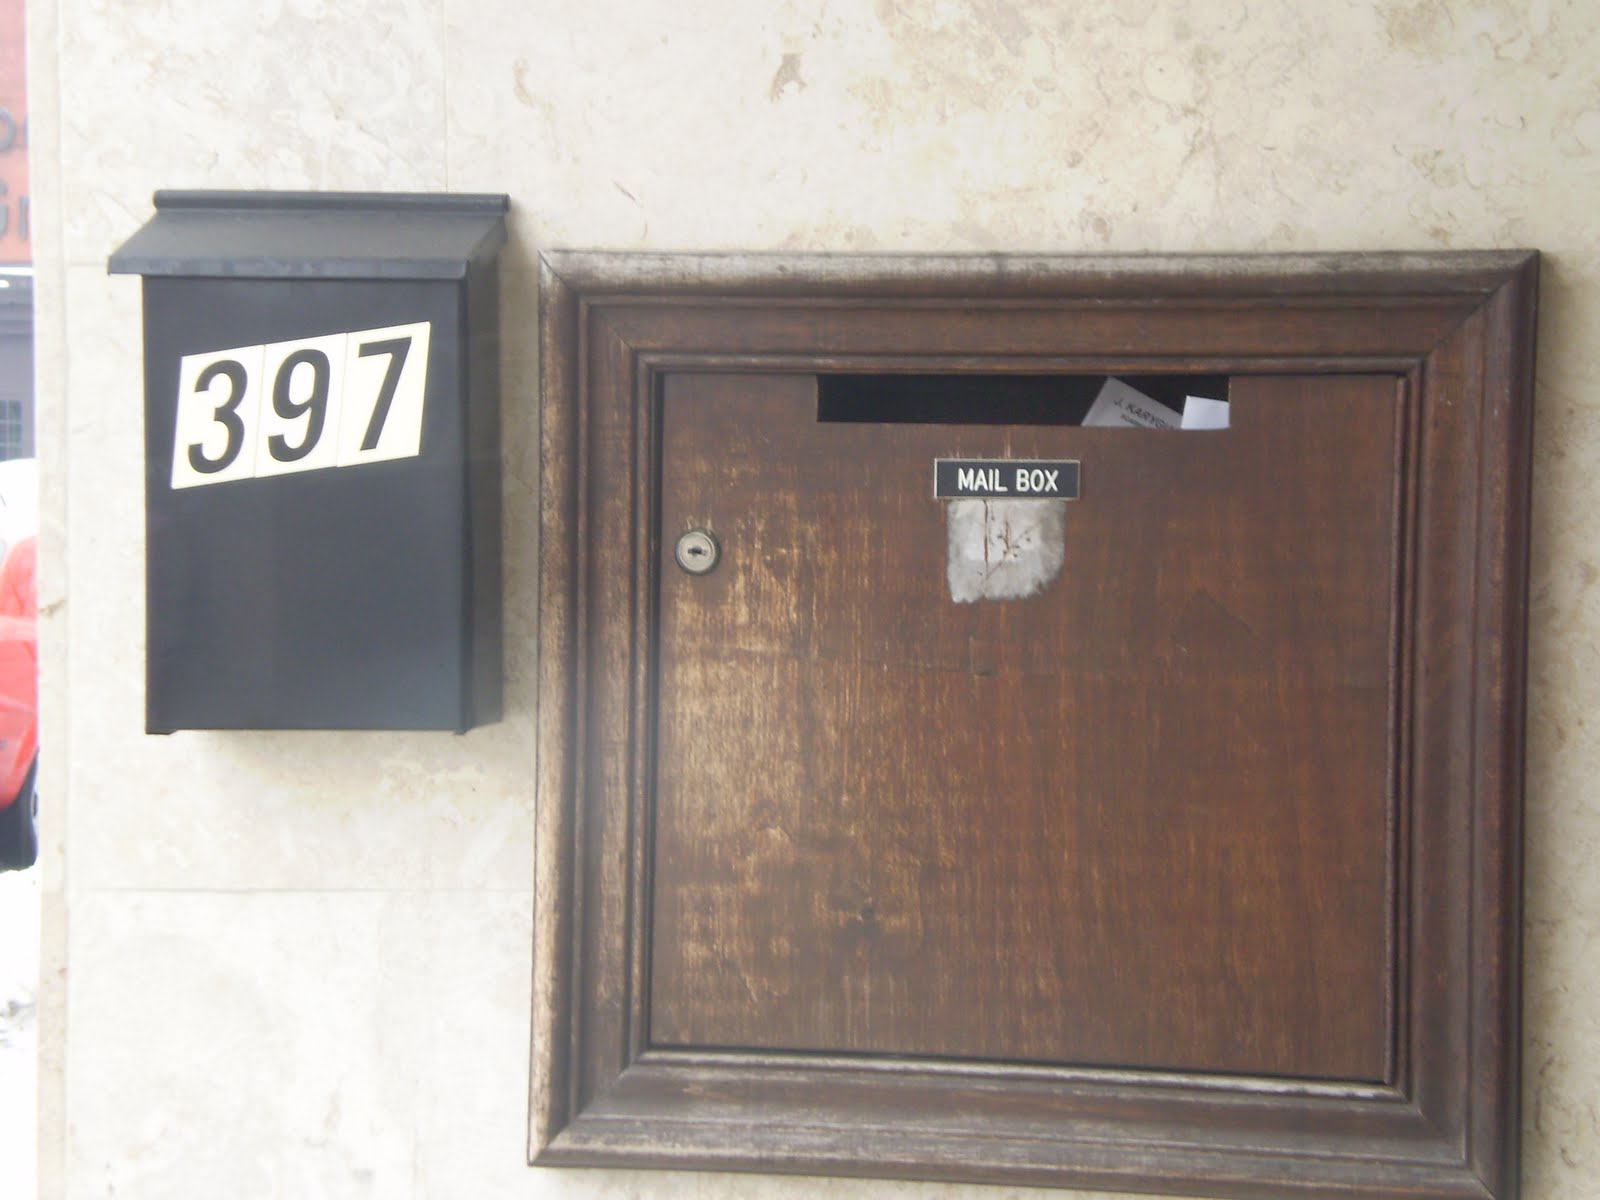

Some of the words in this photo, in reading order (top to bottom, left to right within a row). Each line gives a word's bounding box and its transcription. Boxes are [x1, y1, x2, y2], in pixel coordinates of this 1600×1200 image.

[188, 336, 412, 474] 397
[957, 467, 1008, 492] MAIL
[1016, 468, 1059, 492] BOX
